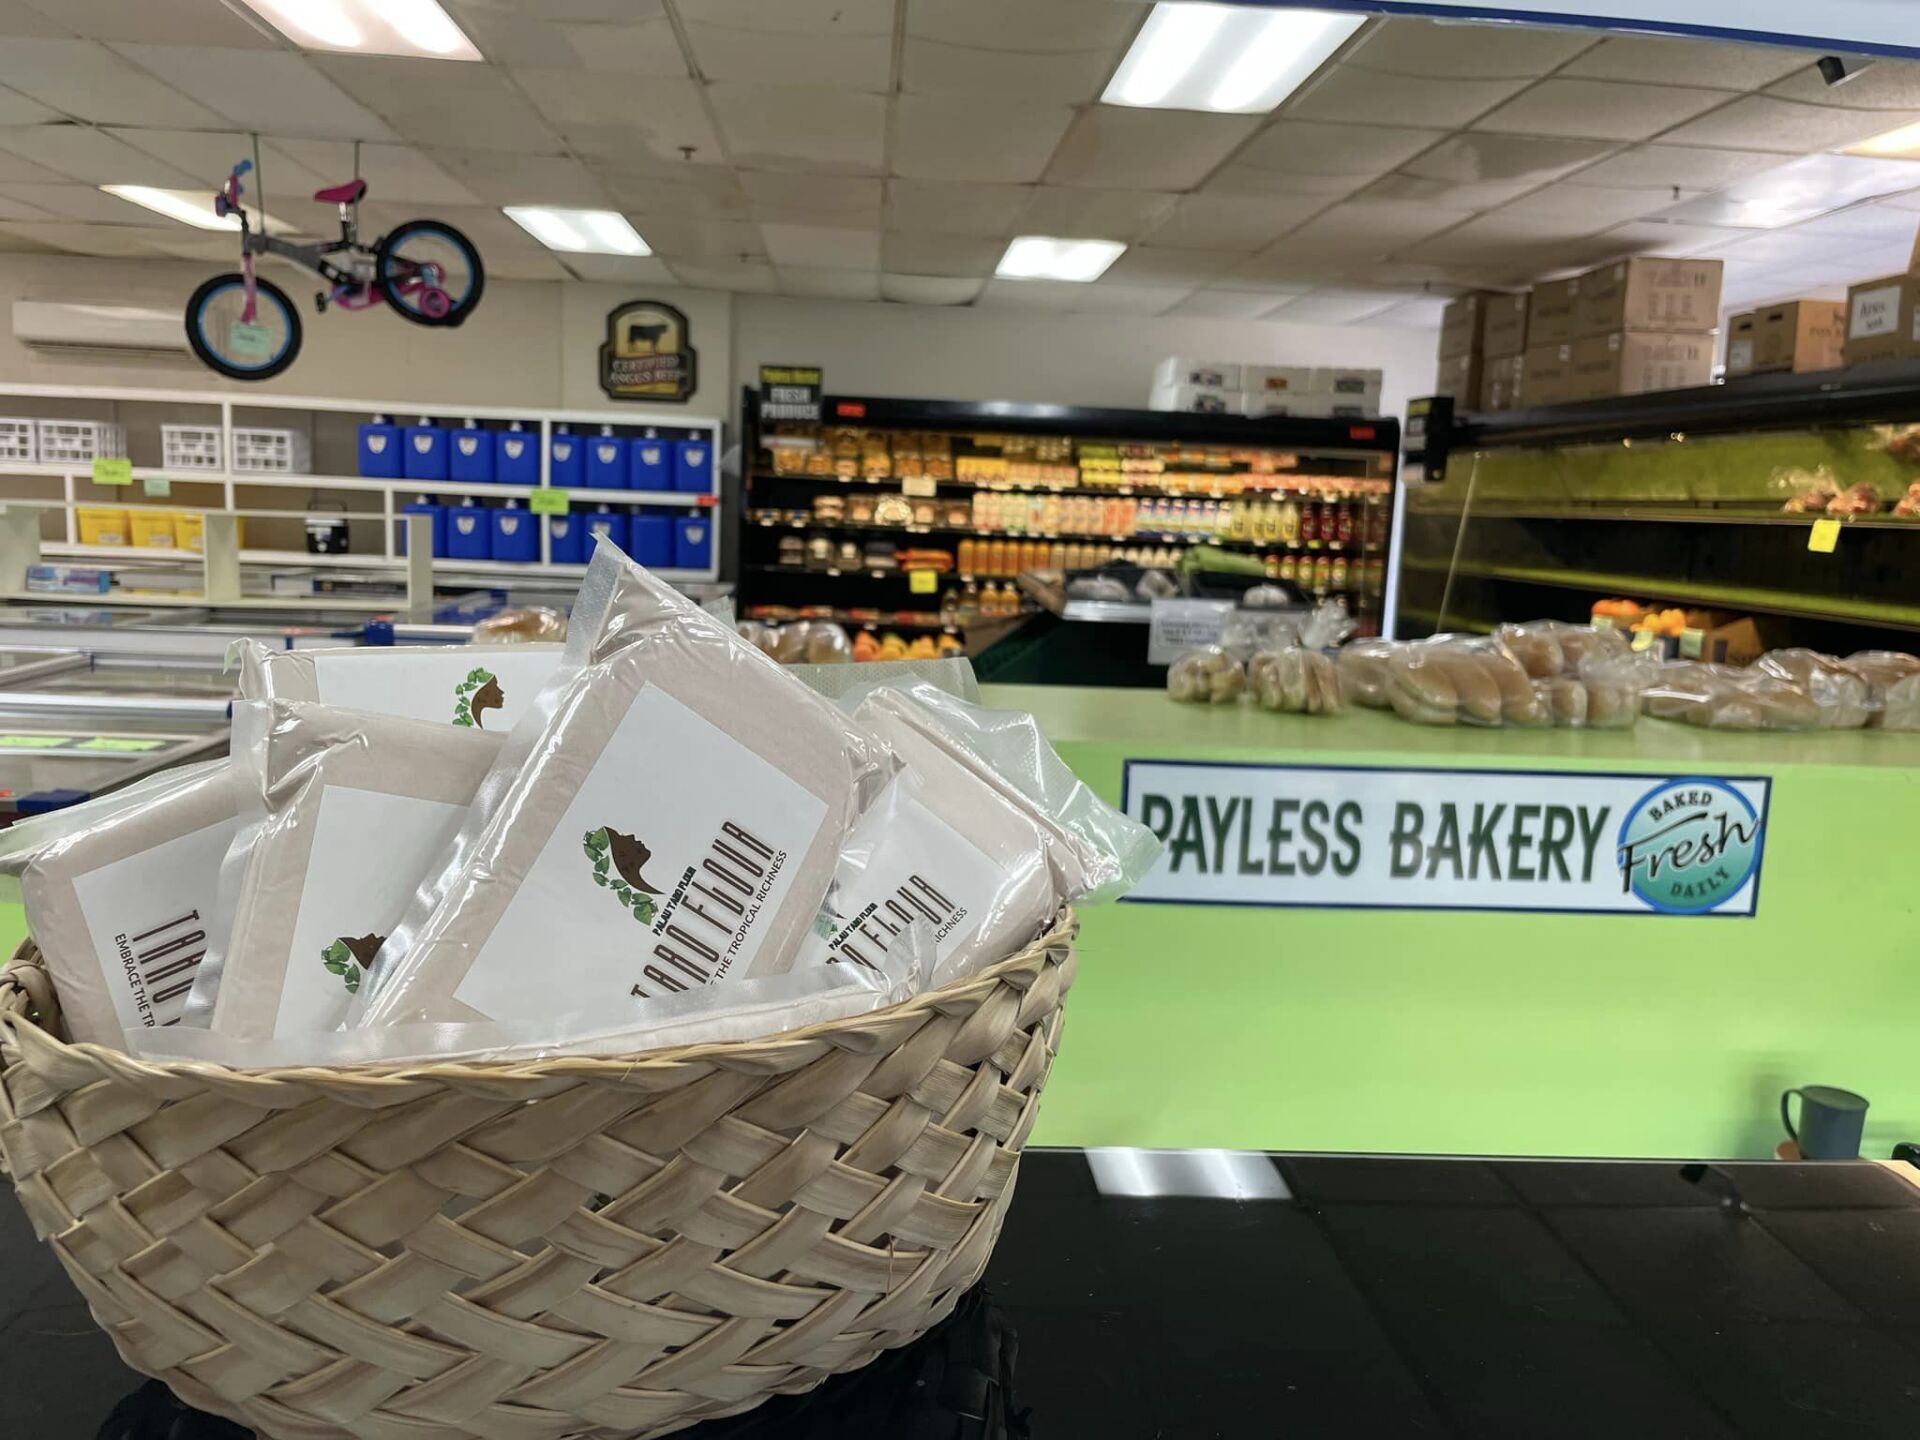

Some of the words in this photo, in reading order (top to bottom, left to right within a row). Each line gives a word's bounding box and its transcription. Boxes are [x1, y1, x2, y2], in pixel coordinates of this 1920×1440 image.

[1141, 793, 1363, 878] PAYLESS
[1389, 801, 1611, 882] BAKERY
[1648, 790, 1713, 821] BAKED
[1618, 812, 1760, 894] Fresh
[1669, 866, 1730, 899] DAILY
[652, 909, 673, 937] PALAU
[666, 888, 684, 910] TARO
[714, 956, 733, 981] THE
[728, 903, 761, 957] TROPICAL
[756, 850, 787, 903] RICHNESS
[935, 907, 967, 943] ICHNESS
[115, 933, 142, 989] EMBRACE
[133, 987, 151, 1013] THE
